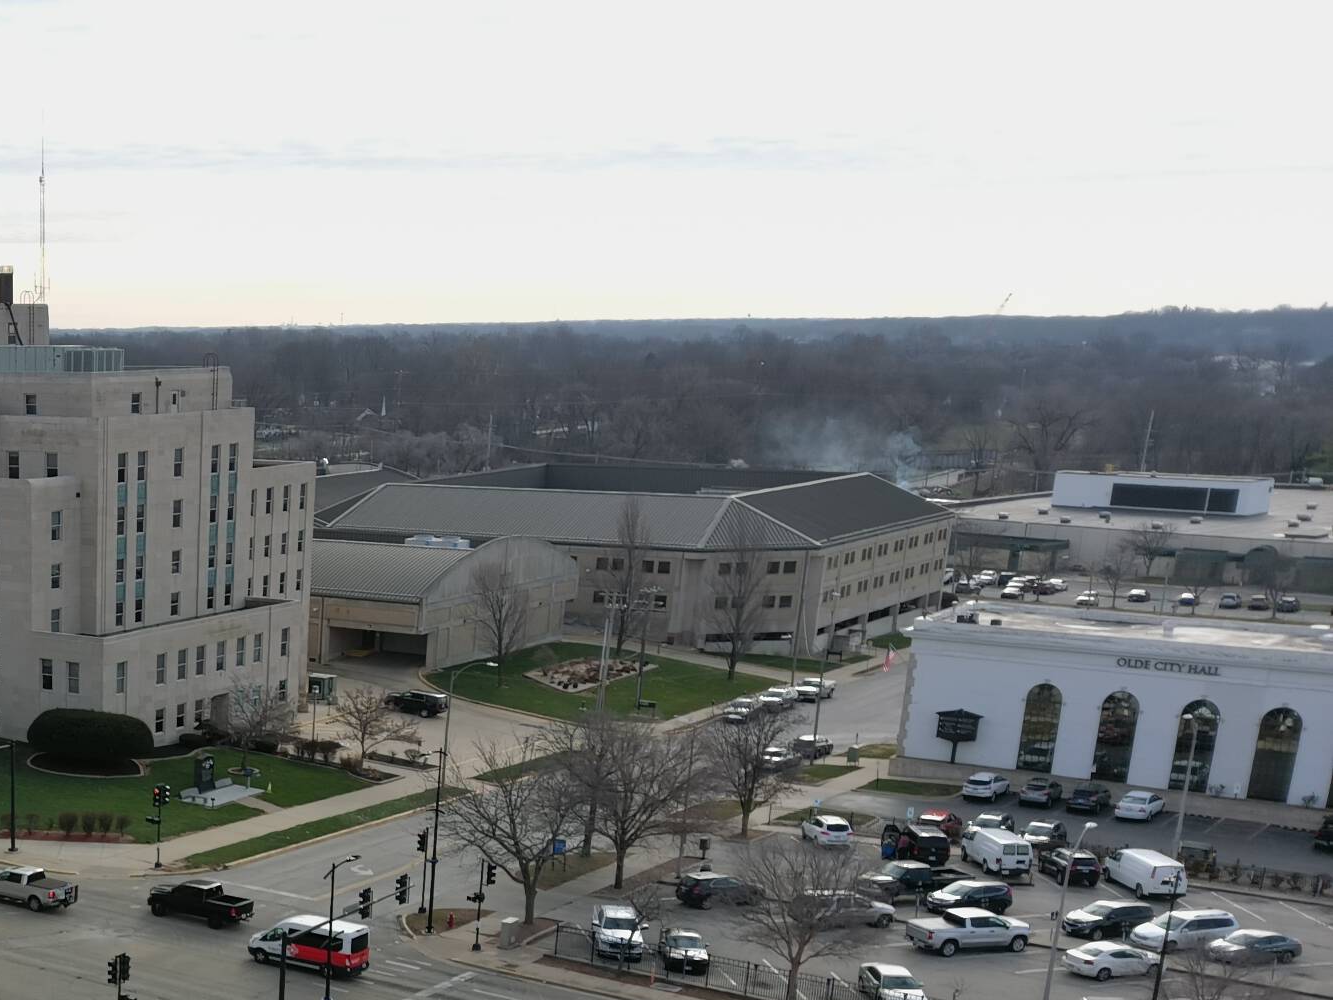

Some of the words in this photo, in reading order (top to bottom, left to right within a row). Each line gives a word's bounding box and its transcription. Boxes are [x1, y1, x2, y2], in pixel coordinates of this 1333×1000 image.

[1116, 657, 1151, 671] OLDE
[1154, 661, 1185, 673] CITY
[1187, 664, 1221, 676] HALL
